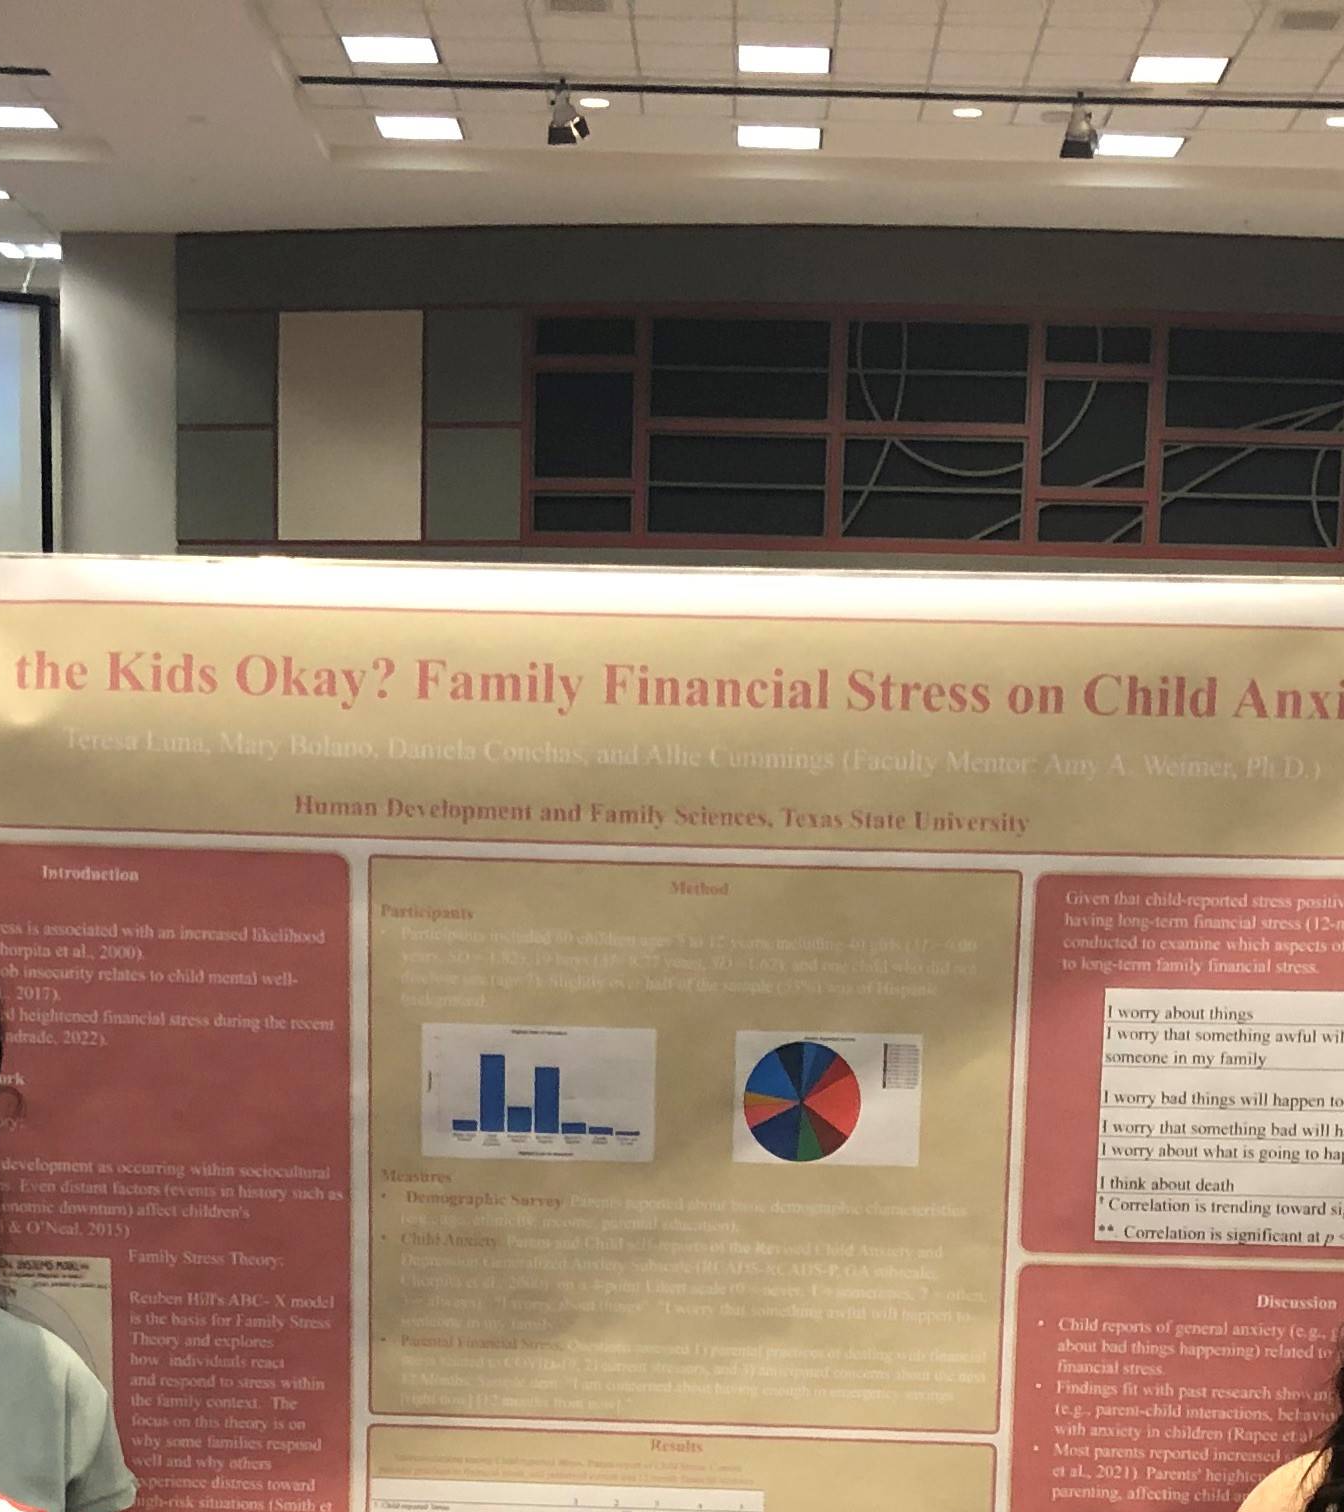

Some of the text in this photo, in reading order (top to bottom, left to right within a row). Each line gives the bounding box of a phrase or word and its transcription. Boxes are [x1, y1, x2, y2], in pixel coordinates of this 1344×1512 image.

[16, 650, 86, 690] the
[108, 651, 217, 693] Kids
[236, 655, 394, 710] Okay?
[417, 659, 584, 715] Family
[605, 664, 828, 708] Financial
[848, 672, 990, 711] Stress
[1008, 684, 1063, 713] on
[1084, 674, 1216, 716] Child
[296, 795, 1028, 837] Human Development and Family Sciences, Texas State University
[42, 865, 138, 880] Introduction
[672, 880, 728, 895] Method
[44, 921, 117, 937] associated
[122, 923, 153, 938] with
[180, 925, 247, 941] increased
[252, 927, 324, 943] likelihood
[1063, 934, 1136, 949] conducted
[1142, 938, 1155, 949] to
[1160, 939, 1220, 950] examine
[1226, 936, 1269, 951] which
[1275, 940, 1326, 955] aspects
[1062, 957, 1318, 975] to long-term family financial stress.
[1107, 1003, 1252, 1024] I worry about things
[1106, 1024, 1112, 1043] I
[1118, 1031, 1156, 1044] worry
[1164, 1027, 1189, 1040] that
[1196, 1028, 1270, 1045] something
[1276, 1029, 1316, 1043] awful
[1105, 1051, 1265, 1069] someone in my family
[1104, 1086, 1109, 1103] I
[1114, 1094, 1154, 1108] worry
[1161, 1091, 1186, 1104] bad
[1192, 1091, 1235, 1109] things
[1240, 1092, 1267, 1105] will
[1273, 1093, 1324, 1111] happen
[1330, 1096, 1344, 1107] to
[1100, 1176, 1233, 1191] I think about death
[1124, 1224, 1205, 1240] Correlation
[1211, 1226, 1221, 1241] is
[1227, 1226, 1301, 1245] significant
[1307, 1231, 1320, 1243] at
[128, 1249, 283, 1269] Family Stress Theory:
[1258, 1295, 1336, 1308] Discussion
[1058, 1359, 1165, 1375] financial stress.
[650, 1438, 704, 1453] Results
